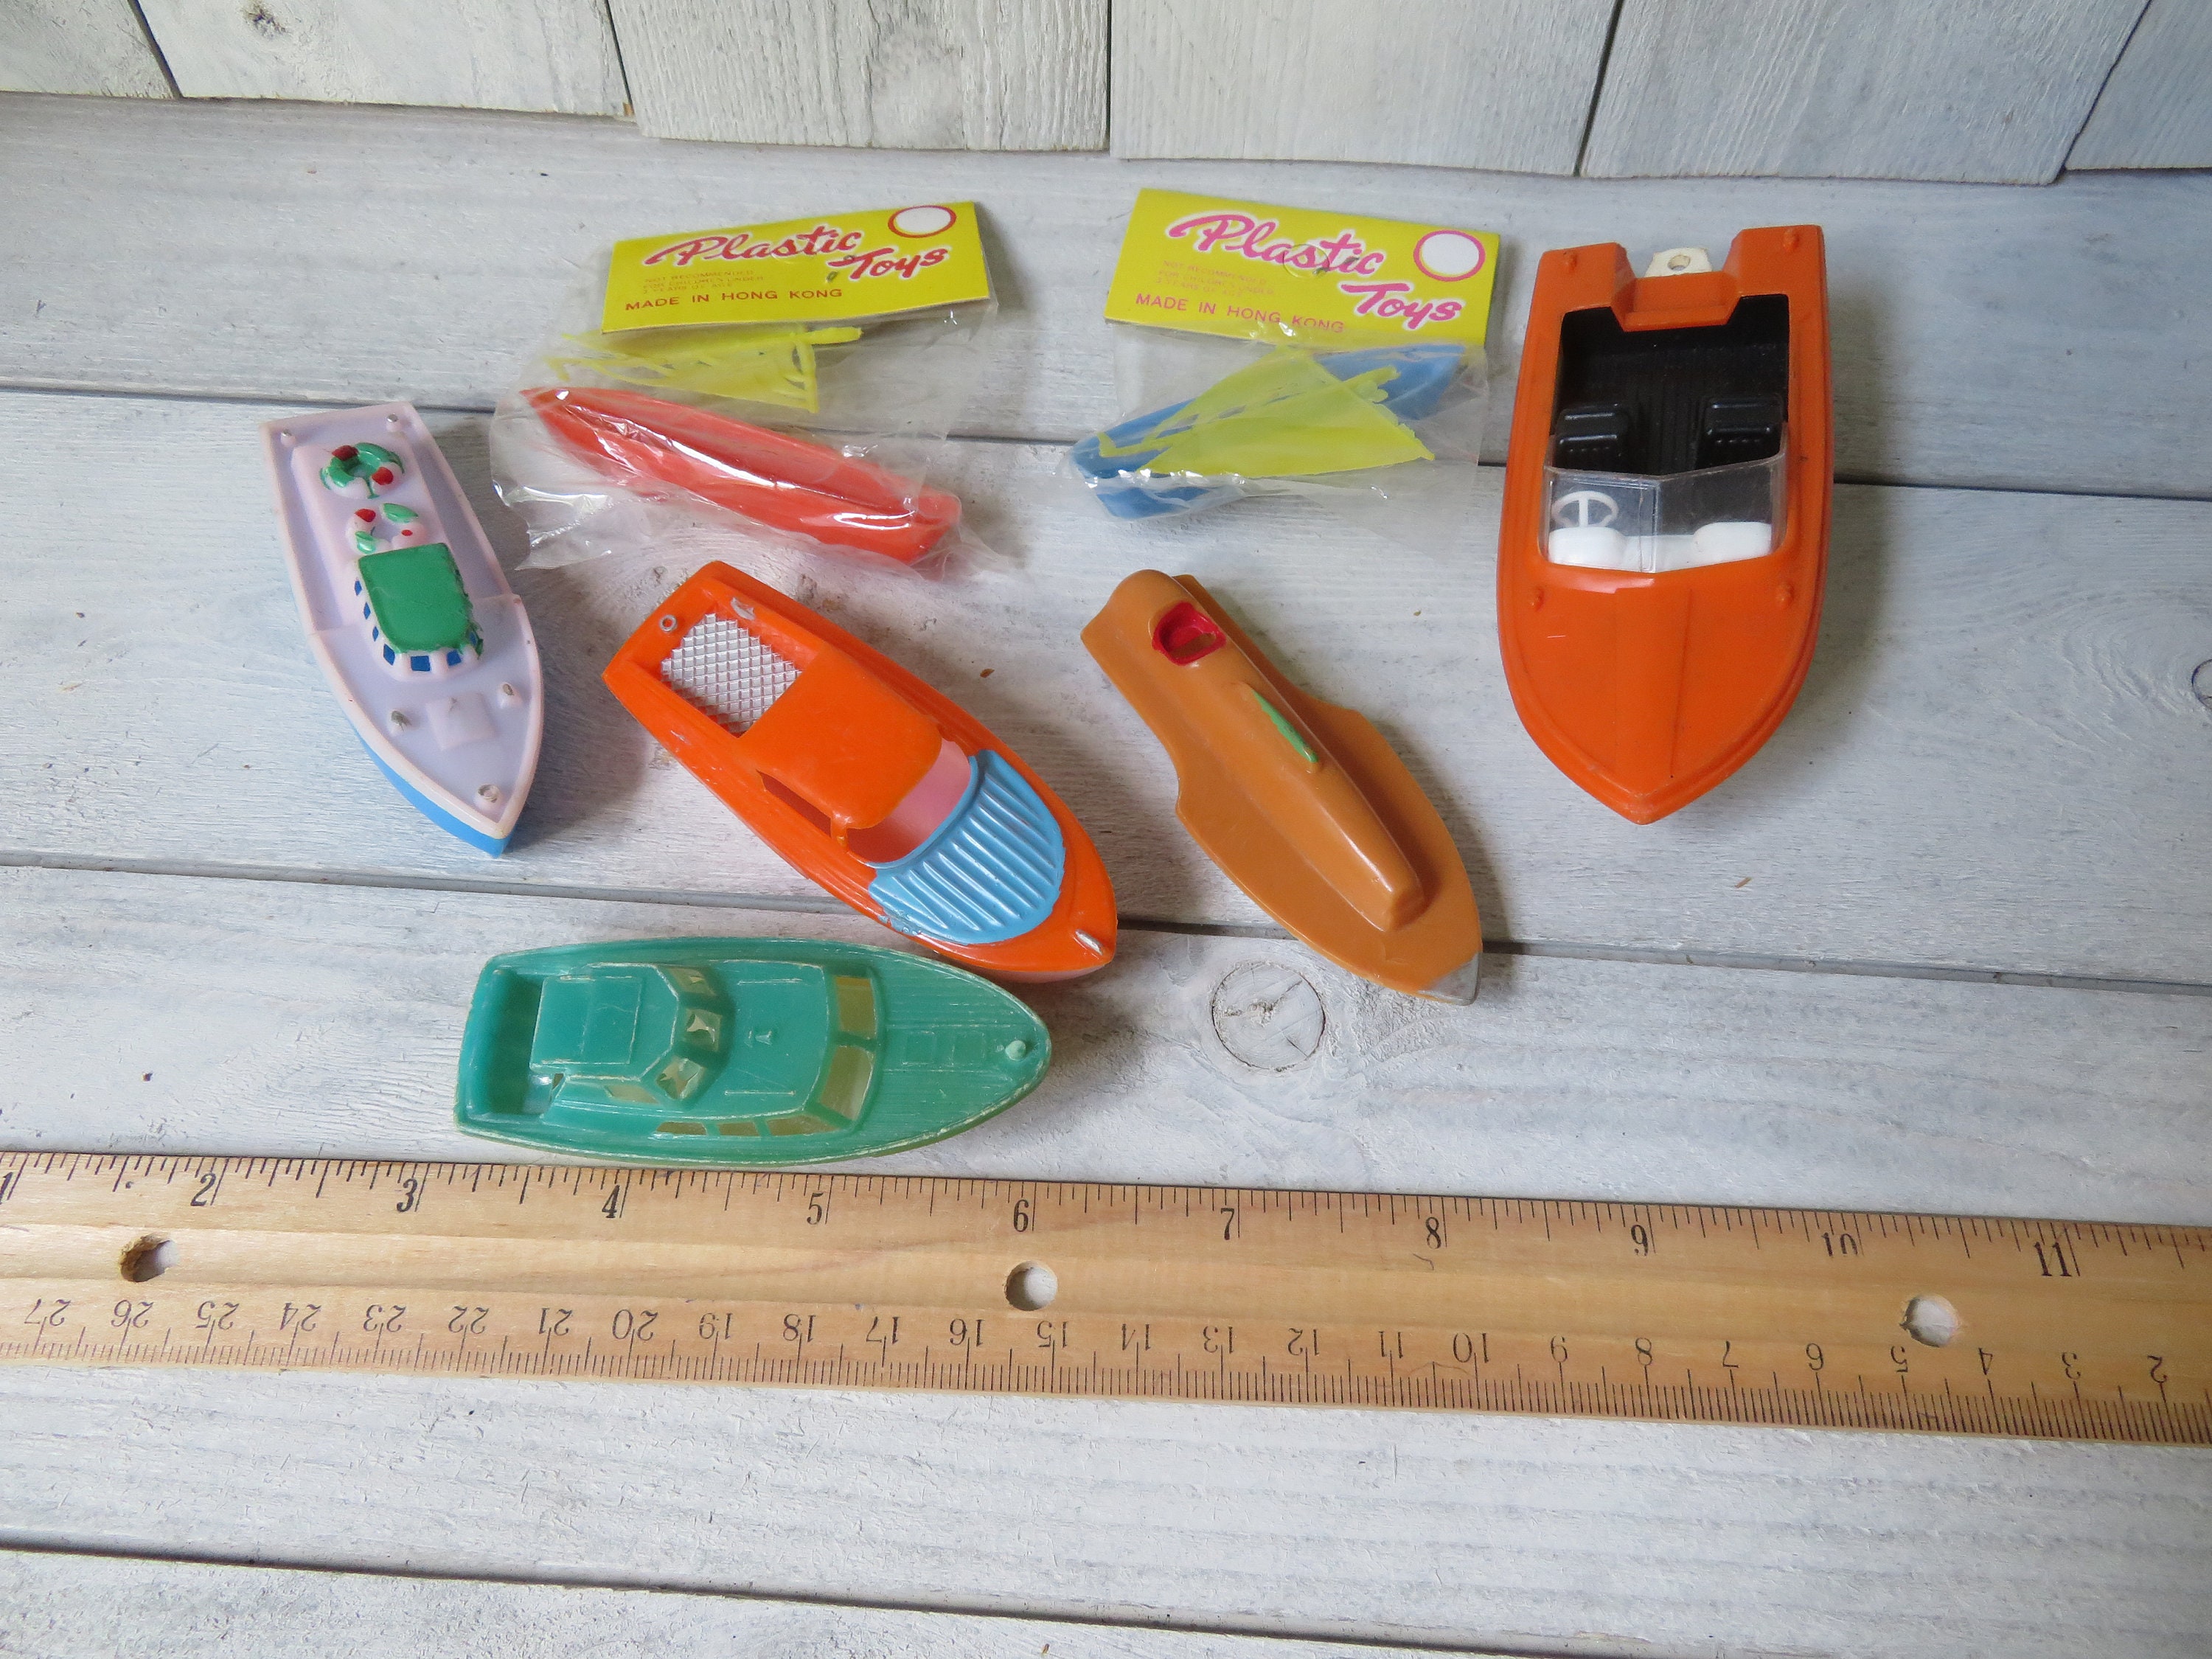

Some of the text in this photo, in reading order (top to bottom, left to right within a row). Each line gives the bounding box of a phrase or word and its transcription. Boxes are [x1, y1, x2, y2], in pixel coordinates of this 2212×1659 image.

[644, 226, 862, 266] Plastic
[1168, 214, 1385, 276] Plastic
[827, 247, 949, 279] Toys
[625, 288, 843, 310] MADE IN HONG KONG
[1135, 293, 1345, 333] MADE IN HONG KONG
[1340, 282, 1463, 330] Toys
[190, 1172, 217, 1206] 2
[396, 1179, 418, 1213] 3
[601, 1185, 619, 1220] 4
[807, 1192, 825, 1225] 5
[1012, 1200, 1030, 1233] 6
[1220, 1208, 1235, 1241] 7
[1425, 1217, 1443, 1249] 8
[1630, 1224, 1649, 1256] 9
[1821, 1232, 1859, 1259] 10
[2034, 1241, 2072, 1278] 11
[25, 1298, 72, 1327] 27
[113, 1299, 153, 1327] 26
[197, 1300, 240, 1330] 25
[279, 1302, 321, 1330] 24
[363, 1305, 406, 1333] 23
[448, 1306, 489, 1333] 22
[538, 1307, 573, 1336] 21
[612, 1309, 659, 1341] 20
[699, 1312, 733, 1340] 19
[782, 1312, 817, 1343] 18
[866, 1315, 901, 1345] 17
[950, 1317, 984, 1346] 16
[1036, 1321, 1069, 1348] 15
[1120, 1324, 1152, 1352] 14
[1202, 1326, 1235, 1354] 13
[1288, 1328, 1320, 1357] 12
[1377, 1330, 1404, 1359] 11
[1452, 1332, 1490, 1364] 10
[1635, 1337, 1654, 1366] 8
[1722, 1340, 1739, 1369] 7
[1891, 1346, 1909, 1374] 5
[1978, 1348, 1994, 1376] 4
[2061, 1352, 2081, 1382] 3
[2147, 1354, 2168, 1384] 2
